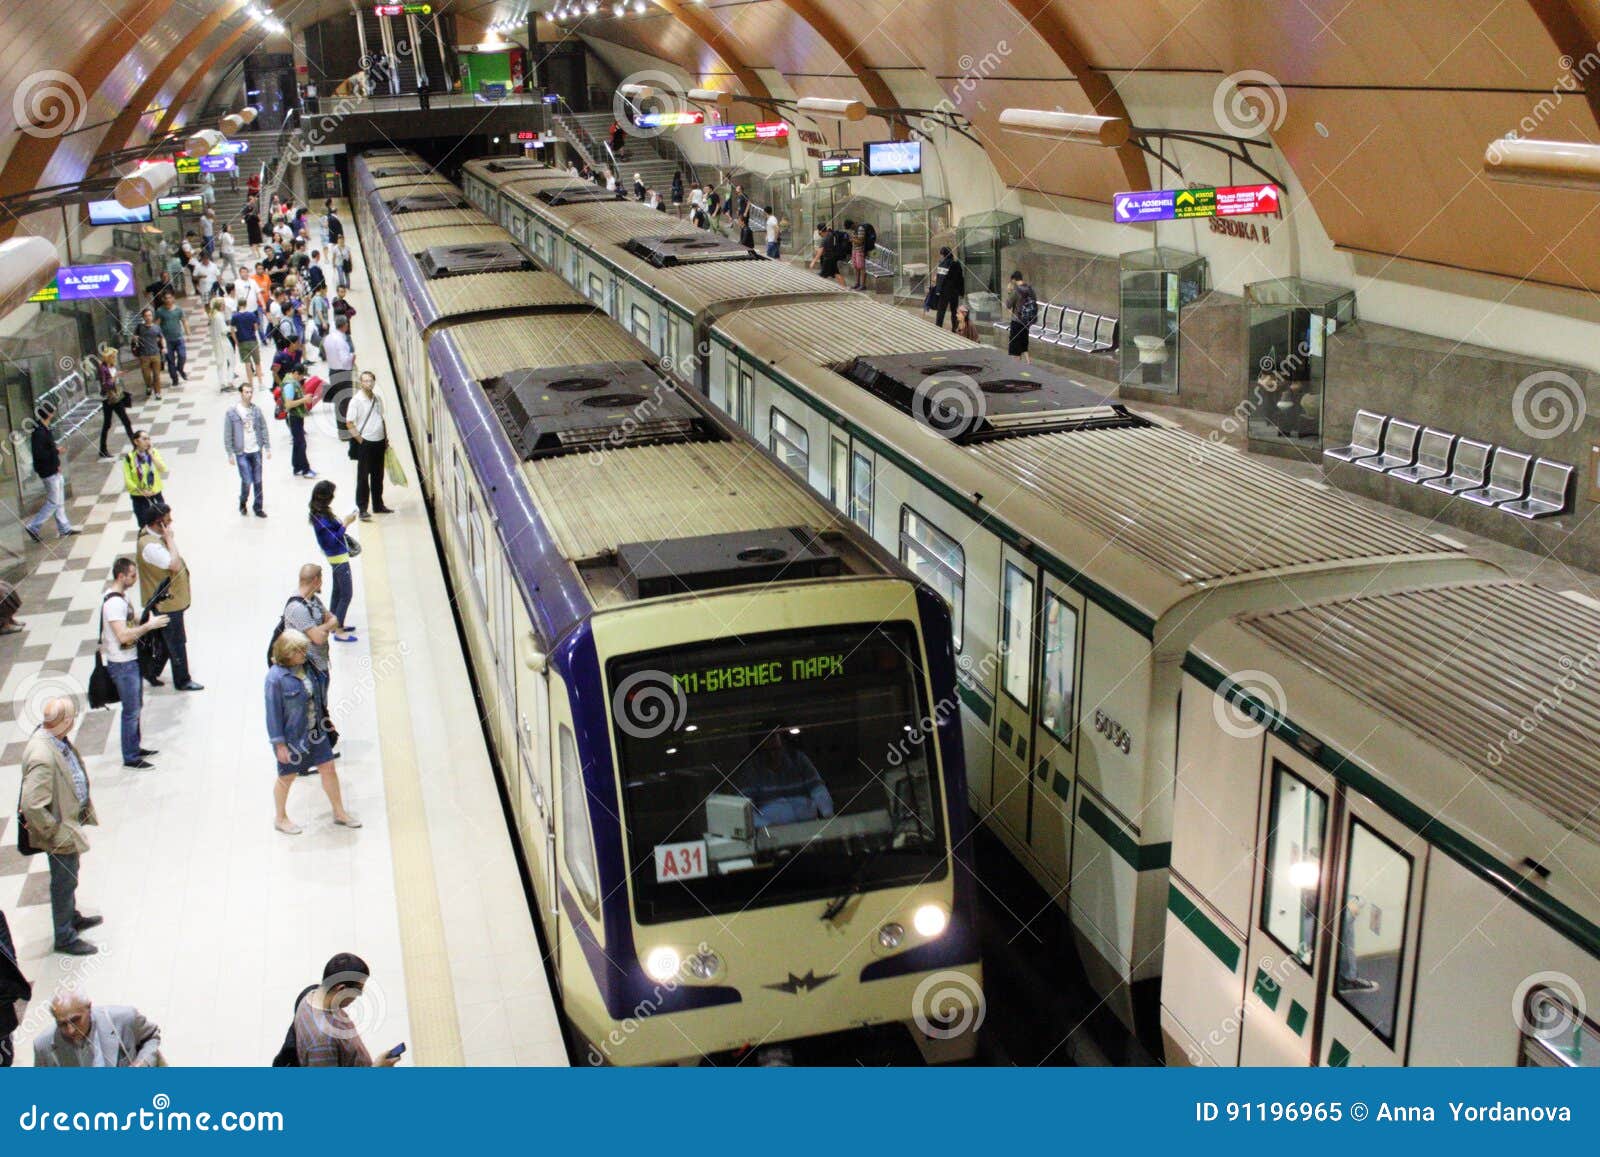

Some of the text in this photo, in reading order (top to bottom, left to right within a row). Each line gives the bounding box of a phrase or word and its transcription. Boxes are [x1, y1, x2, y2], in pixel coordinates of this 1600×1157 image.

[1208, 216, 1259, 242] SERDIKA
[791, 654, 845, 682] ПАРК
[662, 846, 703, 878] A31
